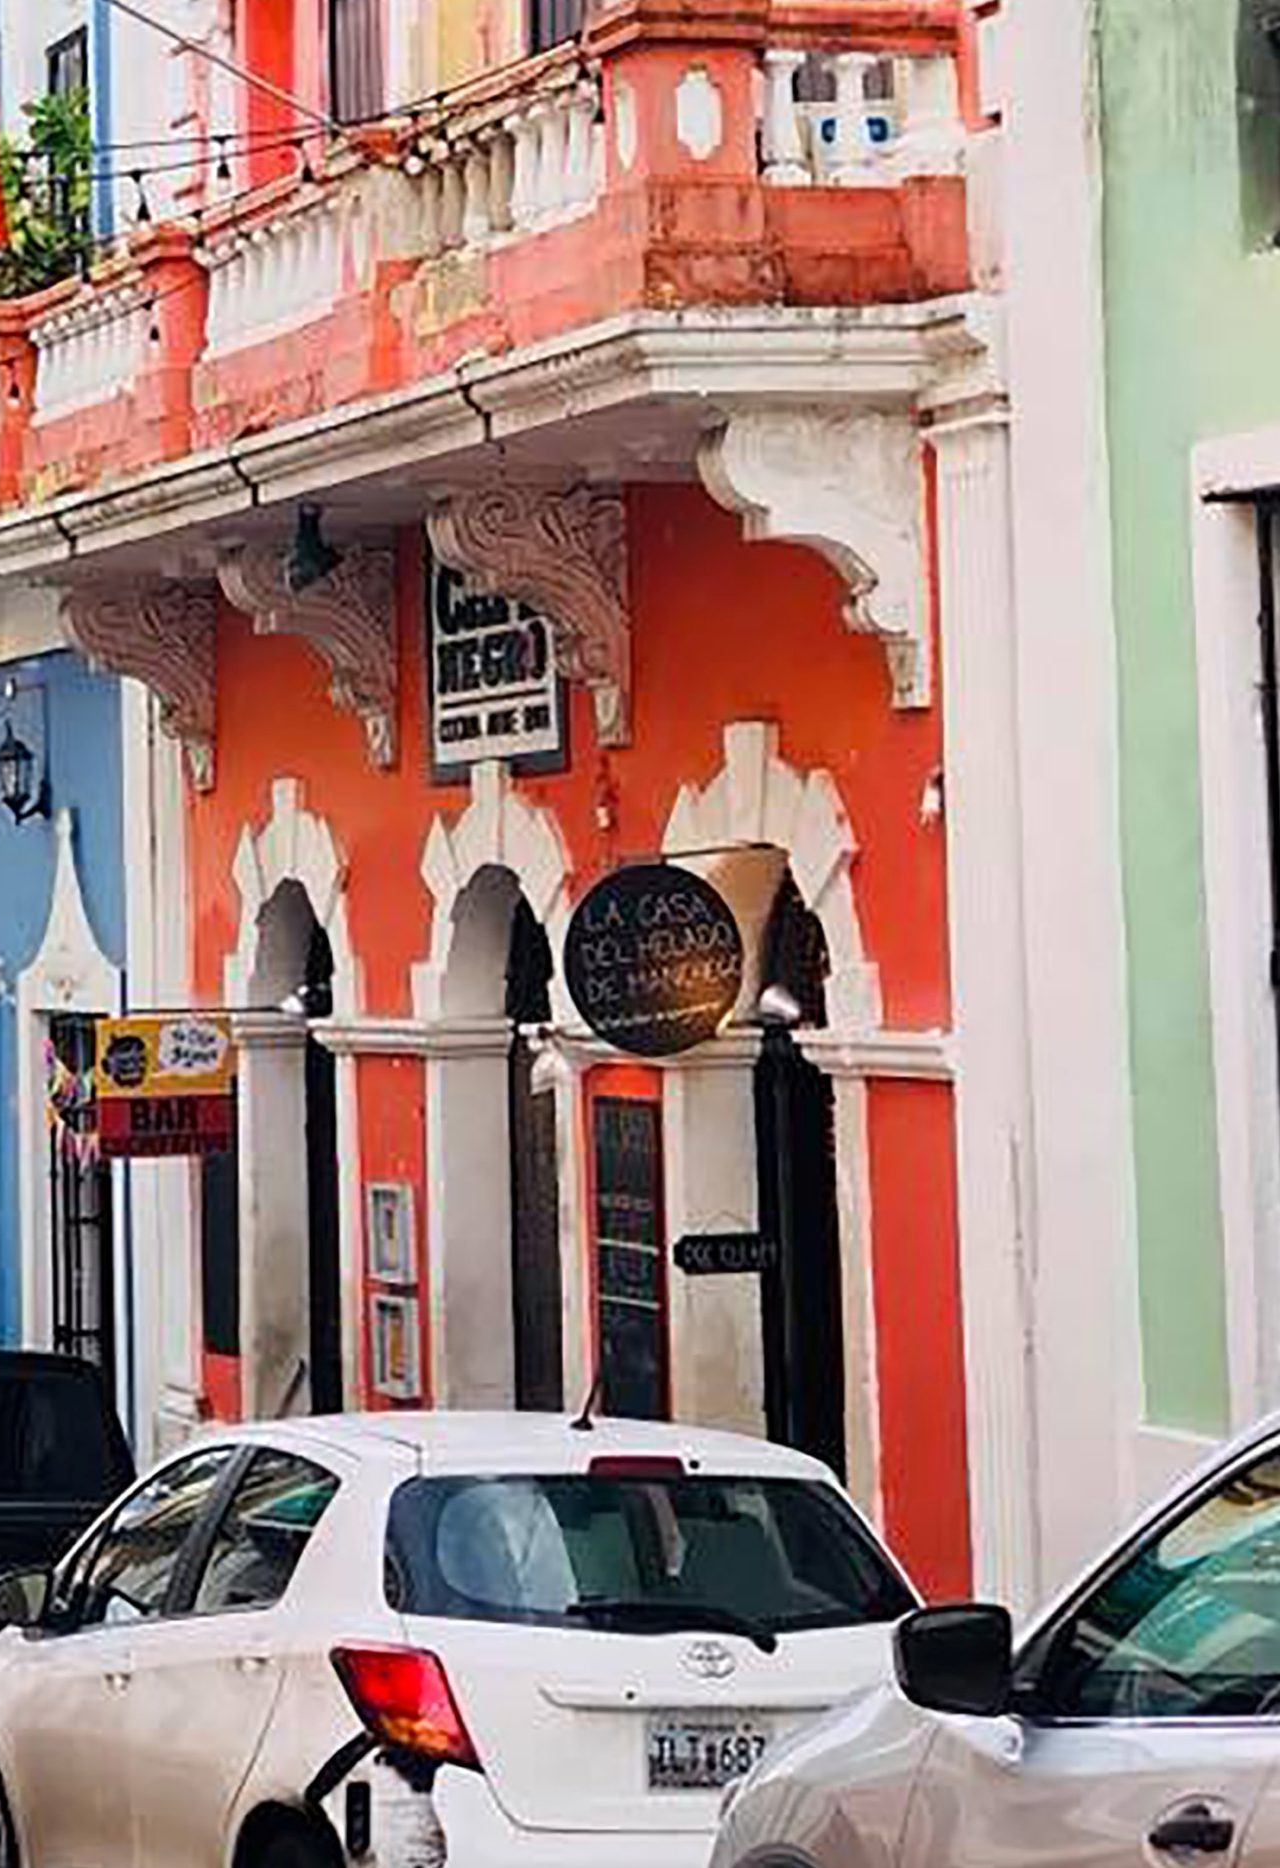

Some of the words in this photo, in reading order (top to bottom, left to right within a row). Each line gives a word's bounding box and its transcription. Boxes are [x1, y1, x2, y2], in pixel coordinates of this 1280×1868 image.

[636, 891, 712, 928] CASA
[580, 936, 634, 971] DEL
[131, 1099, 198, 1131] BAR
